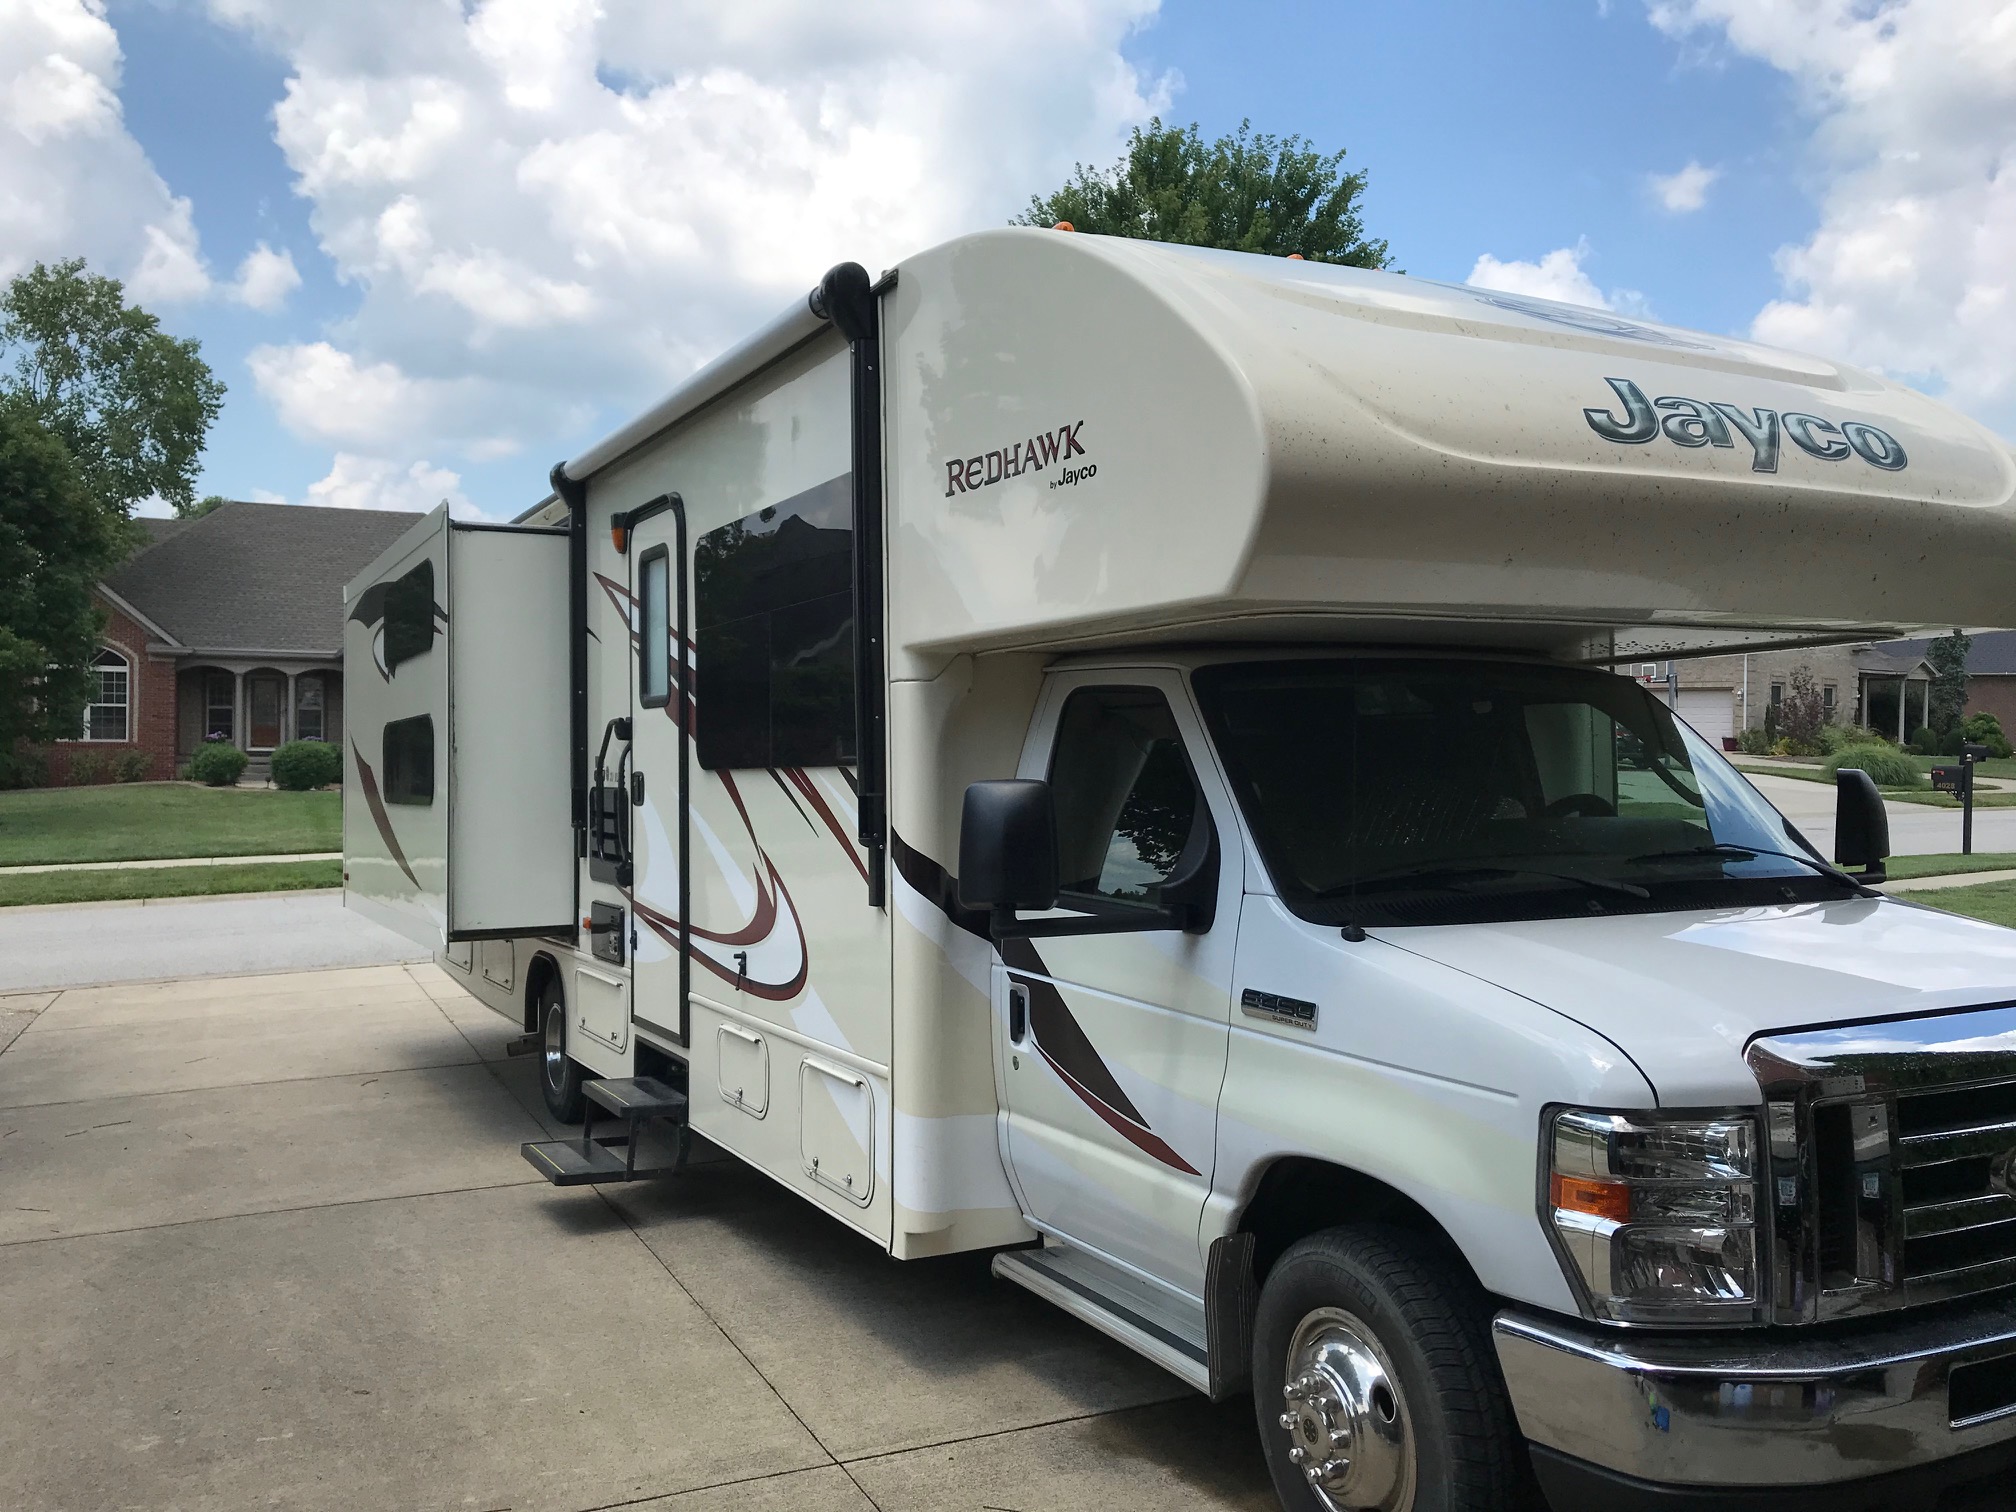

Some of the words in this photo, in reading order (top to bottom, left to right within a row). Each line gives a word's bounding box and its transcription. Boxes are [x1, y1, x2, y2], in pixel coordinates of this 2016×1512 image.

[1583, 377, 1907, 473] Jayco
[945, 420, 1086, 498] REDHAWK
[1050, 480, 1057, 490] by
[1058, 464, 1097, 487] Jayco
[1936, 782, 1955, 790] 4028
[1271, 1014, 1293, 1026] SUPER
[1294, 1020, 1313, 1029] DUTY
